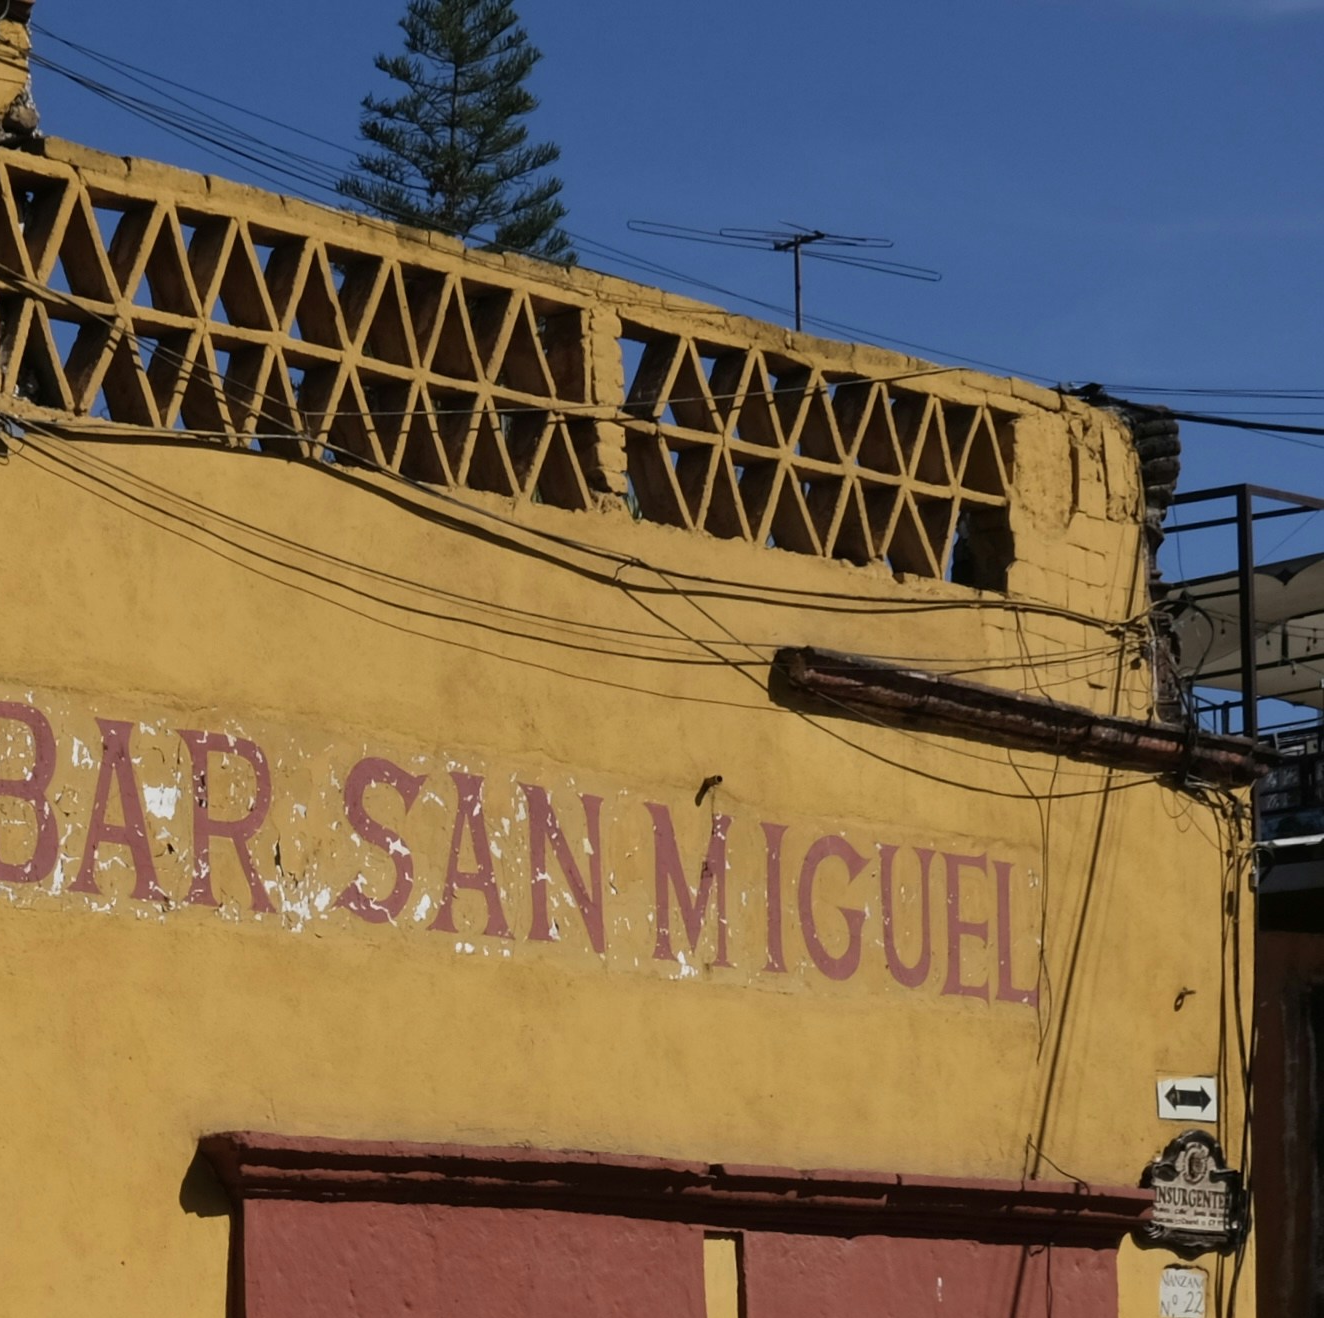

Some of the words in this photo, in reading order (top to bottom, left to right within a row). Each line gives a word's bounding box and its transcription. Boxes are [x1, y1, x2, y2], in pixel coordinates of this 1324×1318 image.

[335, 756, 607, 954] SAN
[645, 801, 1040, 1008] MIGUEL
[1154, 1186, 1228, 1209] INSURGENTE
[1184, 1291, 1205, 1315] 22
